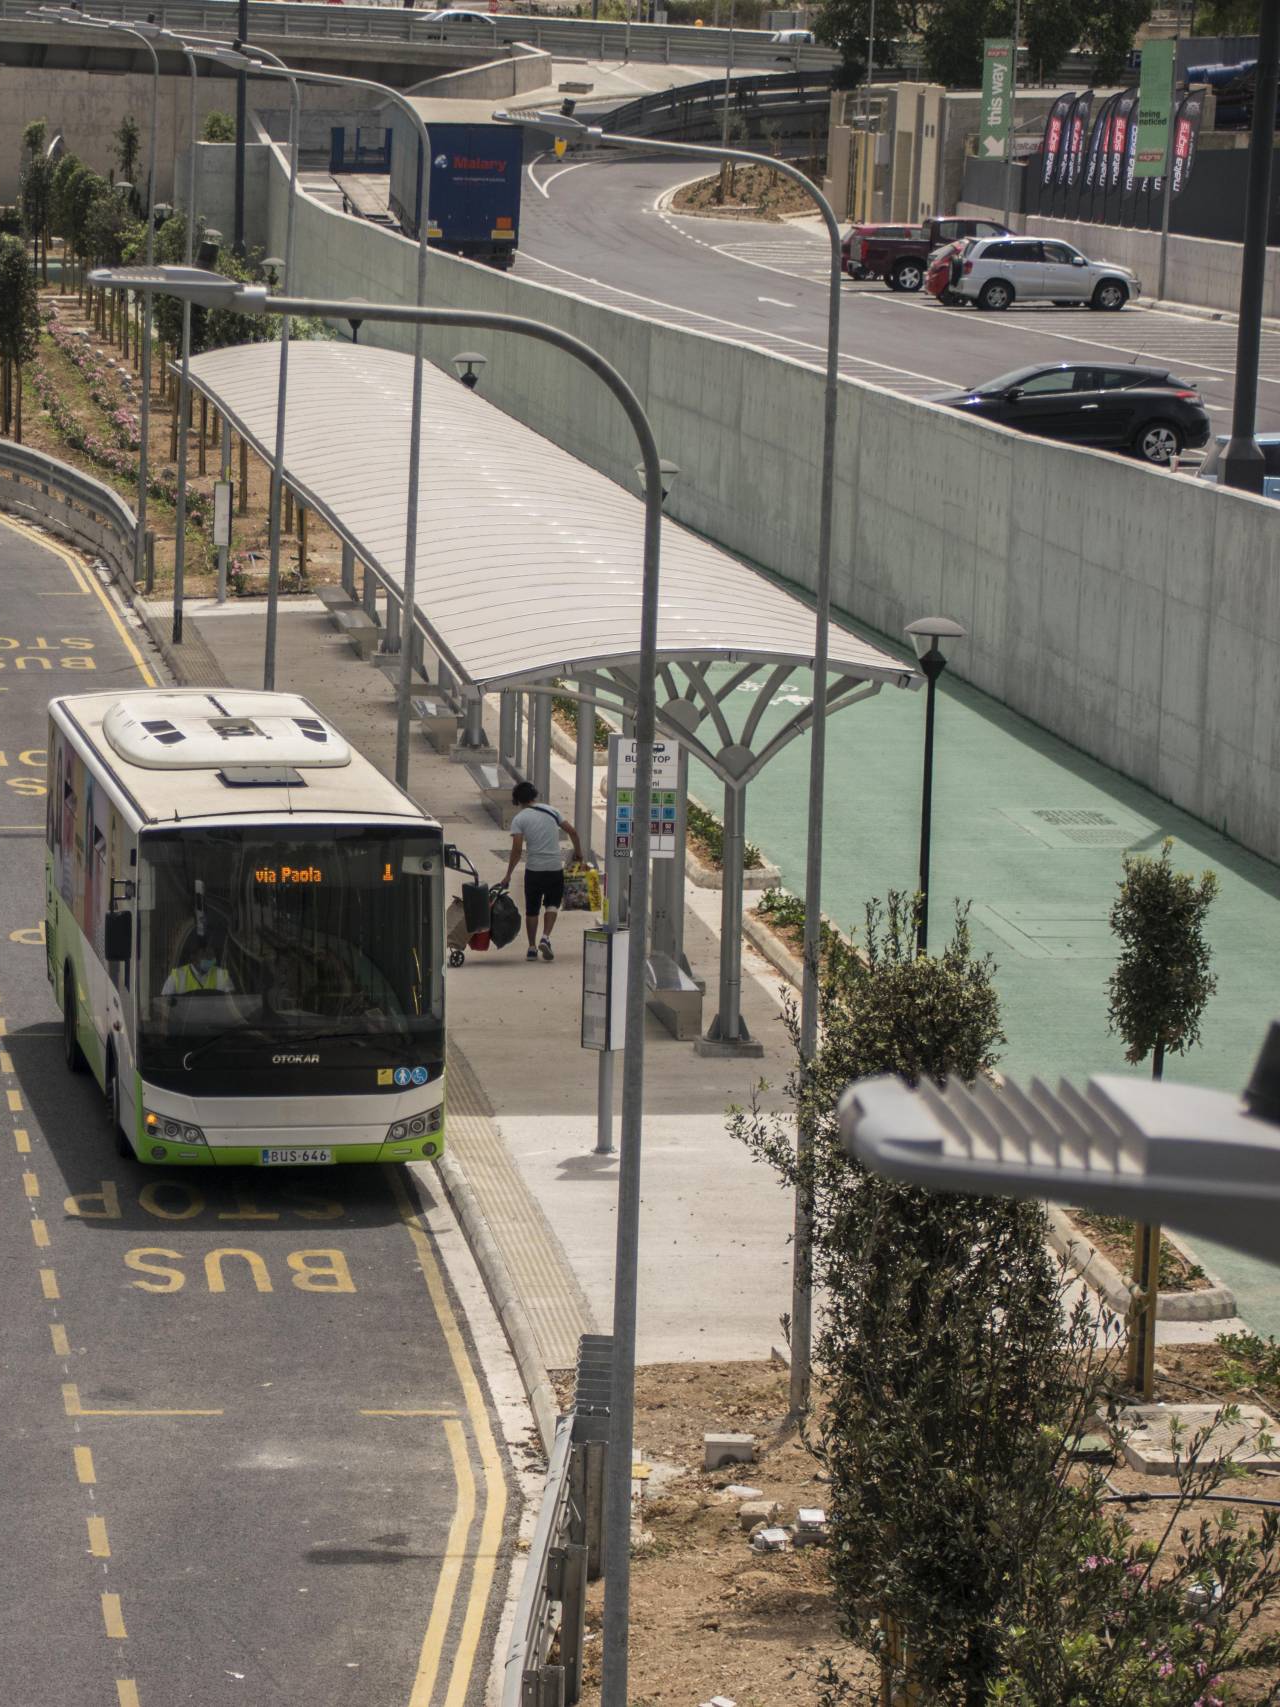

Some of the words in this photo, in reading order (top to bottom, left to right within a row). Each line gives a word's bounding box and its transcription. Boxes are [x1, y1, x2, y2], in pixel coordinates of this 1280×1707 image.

[992, 63, 1008, 95] way
[987, 98, 1004, 126] this
[1175, 120, 1191, 158] signs
[1172, 157, 1184, 192] malta
[255, 867, 276, 882] via
[281, 866, 322, 882] Paola
[383, 863, 394, 881] 1
[272, 1054, 321, 1064] OTOKAR
[271, 1151, 297, 1162] BUS
[302, 1151, 327, 1162] 646
[123, 1247, 358, 1293] BUS
